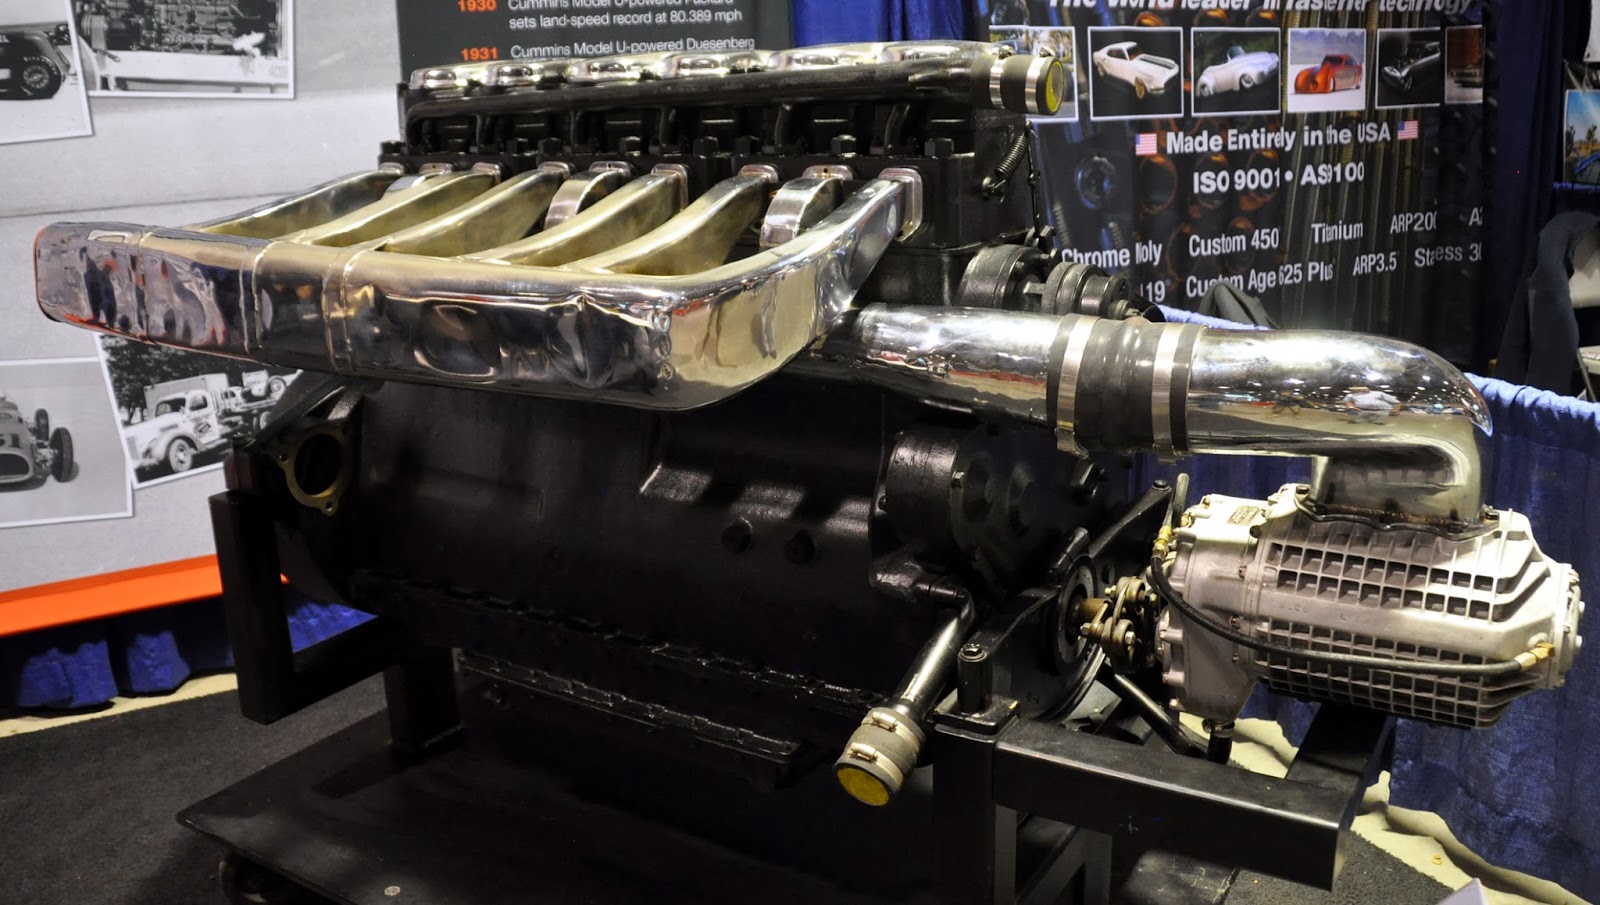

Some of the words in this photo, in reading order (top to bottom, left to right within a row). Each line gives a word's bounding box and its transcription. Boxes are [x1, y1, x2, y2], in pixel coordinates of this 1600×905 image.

[458, 0, 496, 12] 1930
[508, 0, 569, 9] Cummins
[509, 16, 537, 29] sets
[540, 12, 609, 28] land-speed
[613, 11, 652, 25] record
[655, 11, 667, 23] at
[670, 9, 712, 23] 80.389
[715, 8, 742, 25] mph
[460, 48, 498, 61] 1931
[510, 45, 571, 59] Cummins
[574, 42, 613, 56] Model
[616, 40, 683, 54] U-powered
[686, 37, 755, 51] Duesenberg
[1167, 130, 1223, 154] Made
[1227, 126, 1296, 151] Entirely
[1304, 125, 1323, 146] in
[1327, 125, 1352, 144] the
[1357, 122, 1391, 143] USA
[1193, 172, 1229, 194] ISO
[1234, 167, 1280, 190] 9001
[1189, 233, 1246, 258] Custom
[1251, 227, 1279, 250] 450
[1311, 220, 1364, 244] Titanium
[1061, 248, 1131, 268] Chrome
[1353, 251, 1397, 276] ARP3.5
[1186, 273, 1244, 298] Cum
[1248, 268, 1276, 293] Age
[1278, 262, 1302, 286] 625
[1308, 261, 1334, 282] Plus
